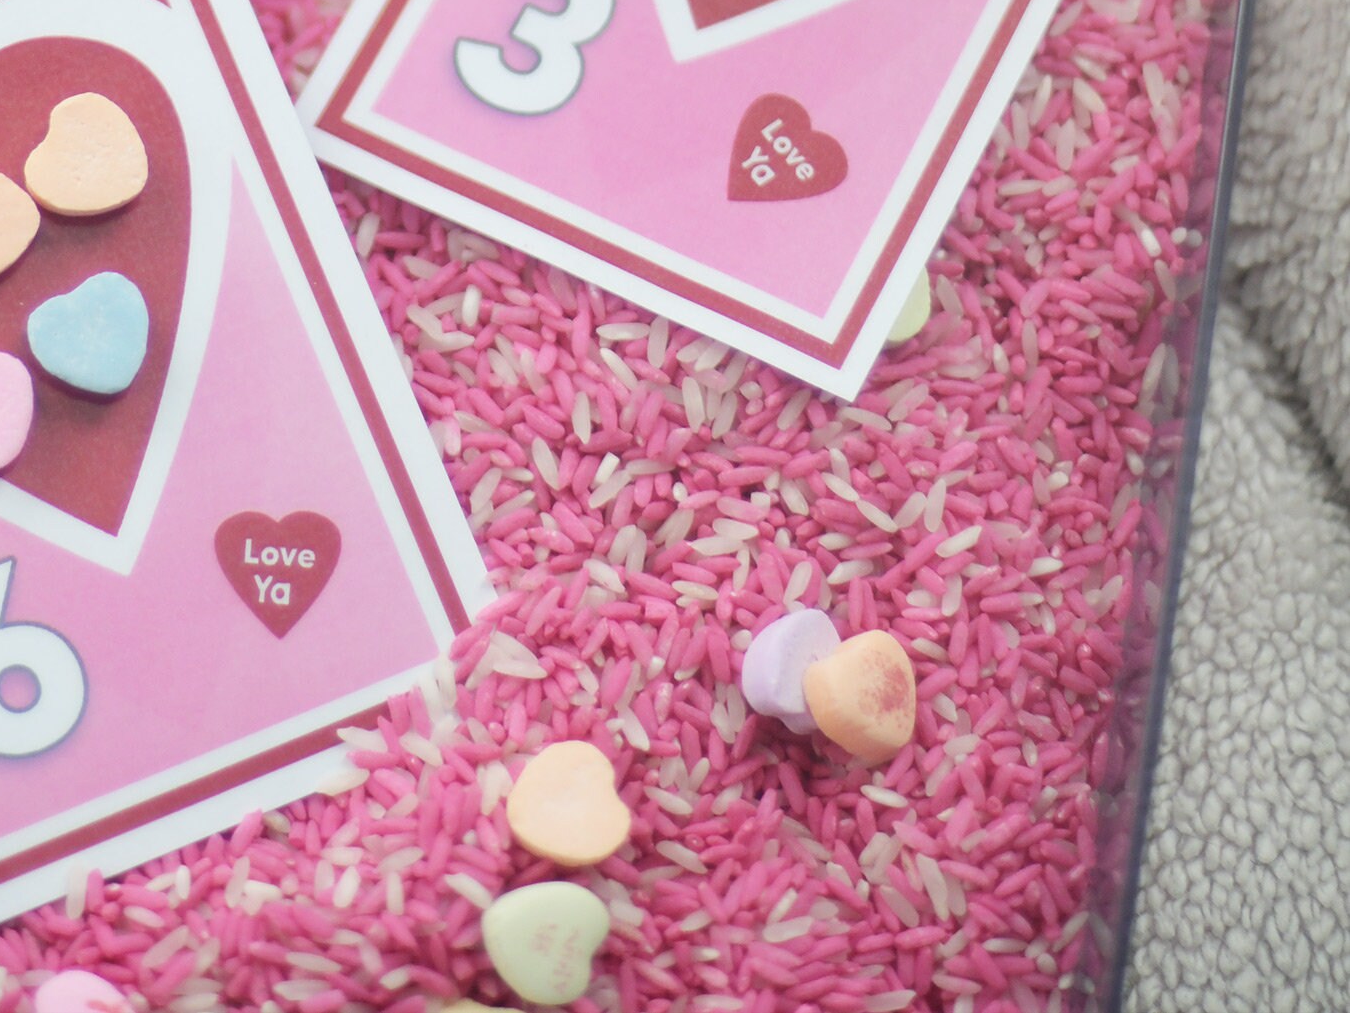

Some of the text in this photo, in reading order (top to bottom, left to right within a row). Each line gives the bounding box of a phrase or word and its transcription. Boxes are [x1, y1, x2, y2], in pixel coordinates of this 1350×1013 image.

[741, 145, 776, 187] Ya
[761, 118, 815, 182] Love
[244, 537, 316, 569] Love
[253, 574, 292, 606] Ya
